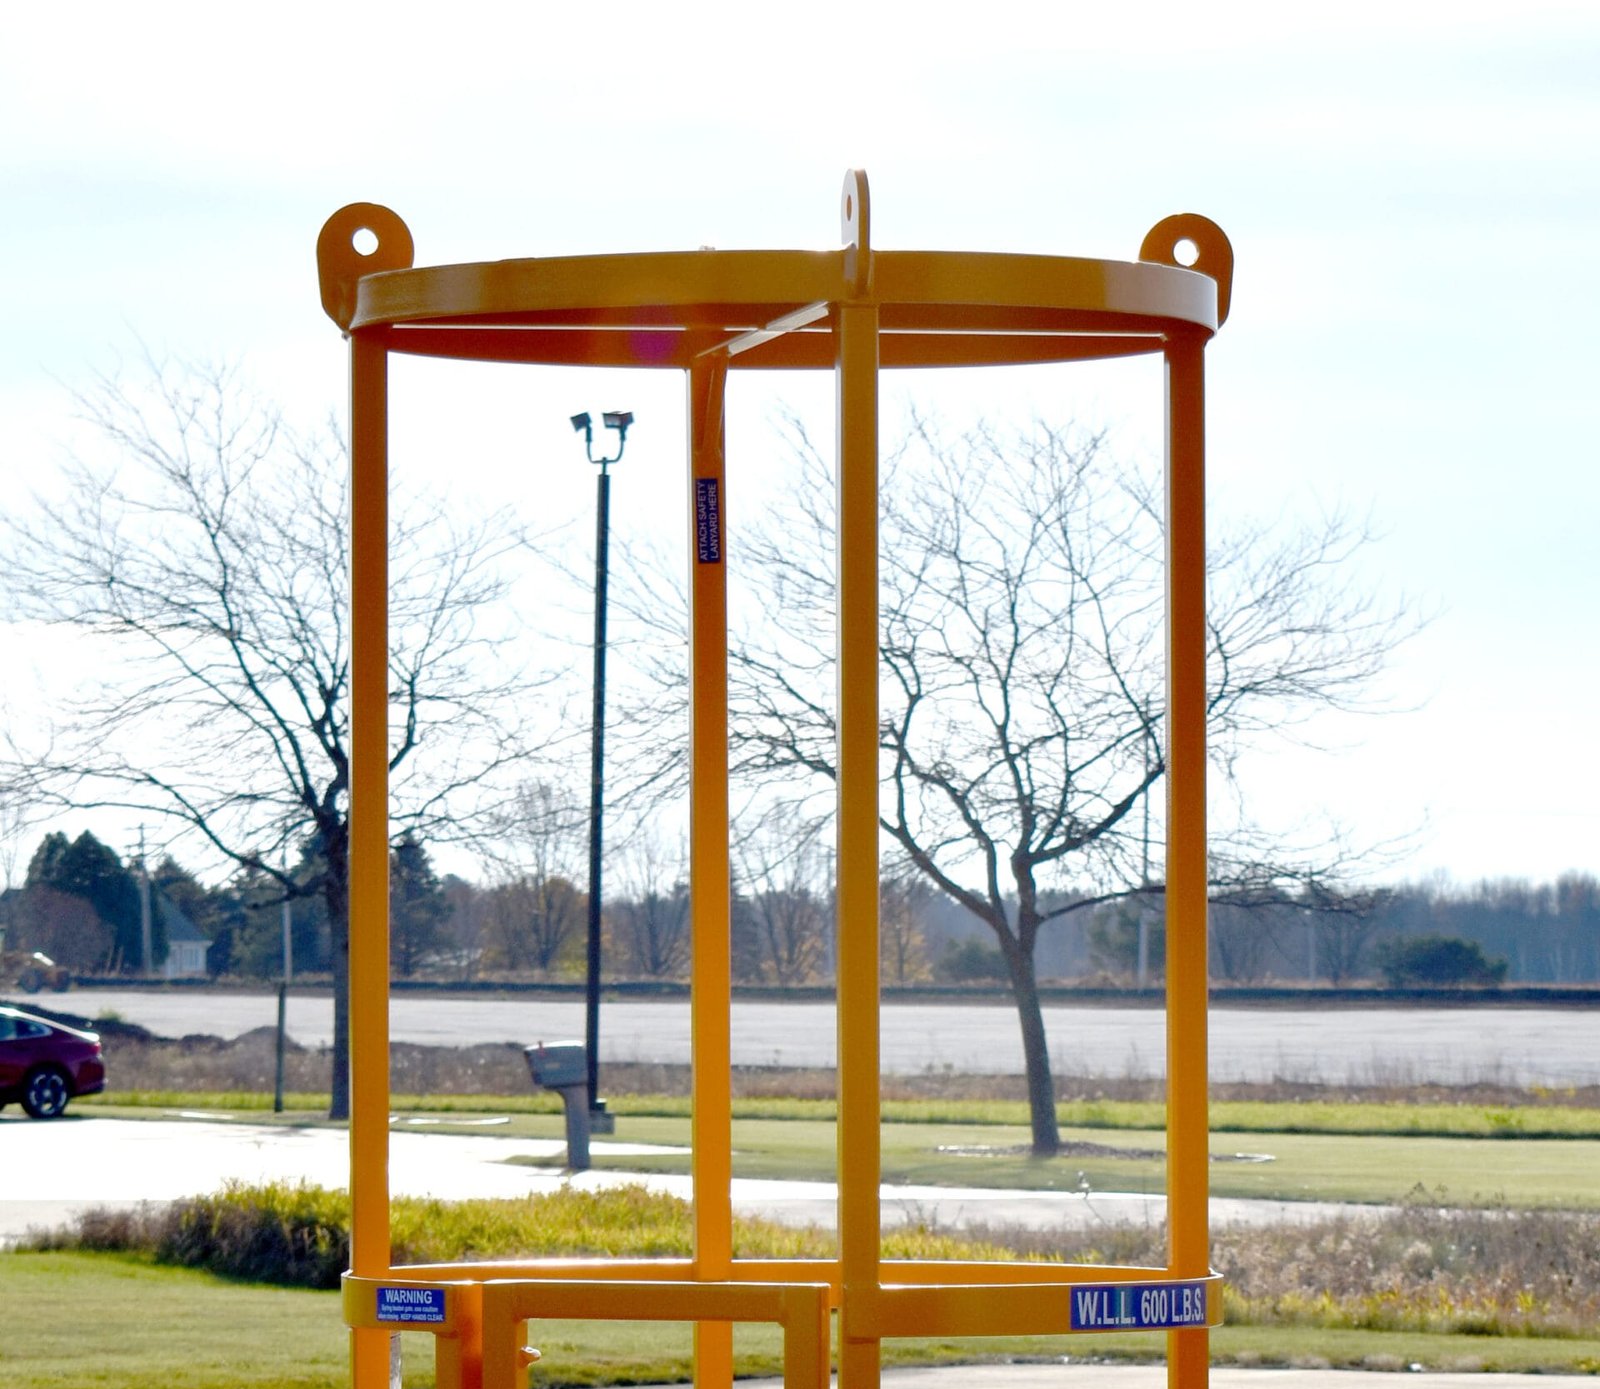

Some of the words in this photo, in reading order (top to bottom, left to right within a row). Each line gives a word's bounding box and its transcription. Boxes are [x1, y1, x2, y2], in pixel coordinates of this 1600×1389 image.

[698, 482, 707, 520] SAFETY
[708, 484, 717, 510] HERE
[699, 522, 708, 560] ATTACH
[709, 513, 718, 558] LANYARD
[386, 1289, 432, 1304] WARNING
[1077, 1292, 1135, 1325] W.L.L.
[1141, 1290, 1167, 1323] 600
[1172, 1288, 1204, 1322] L.B.S.
